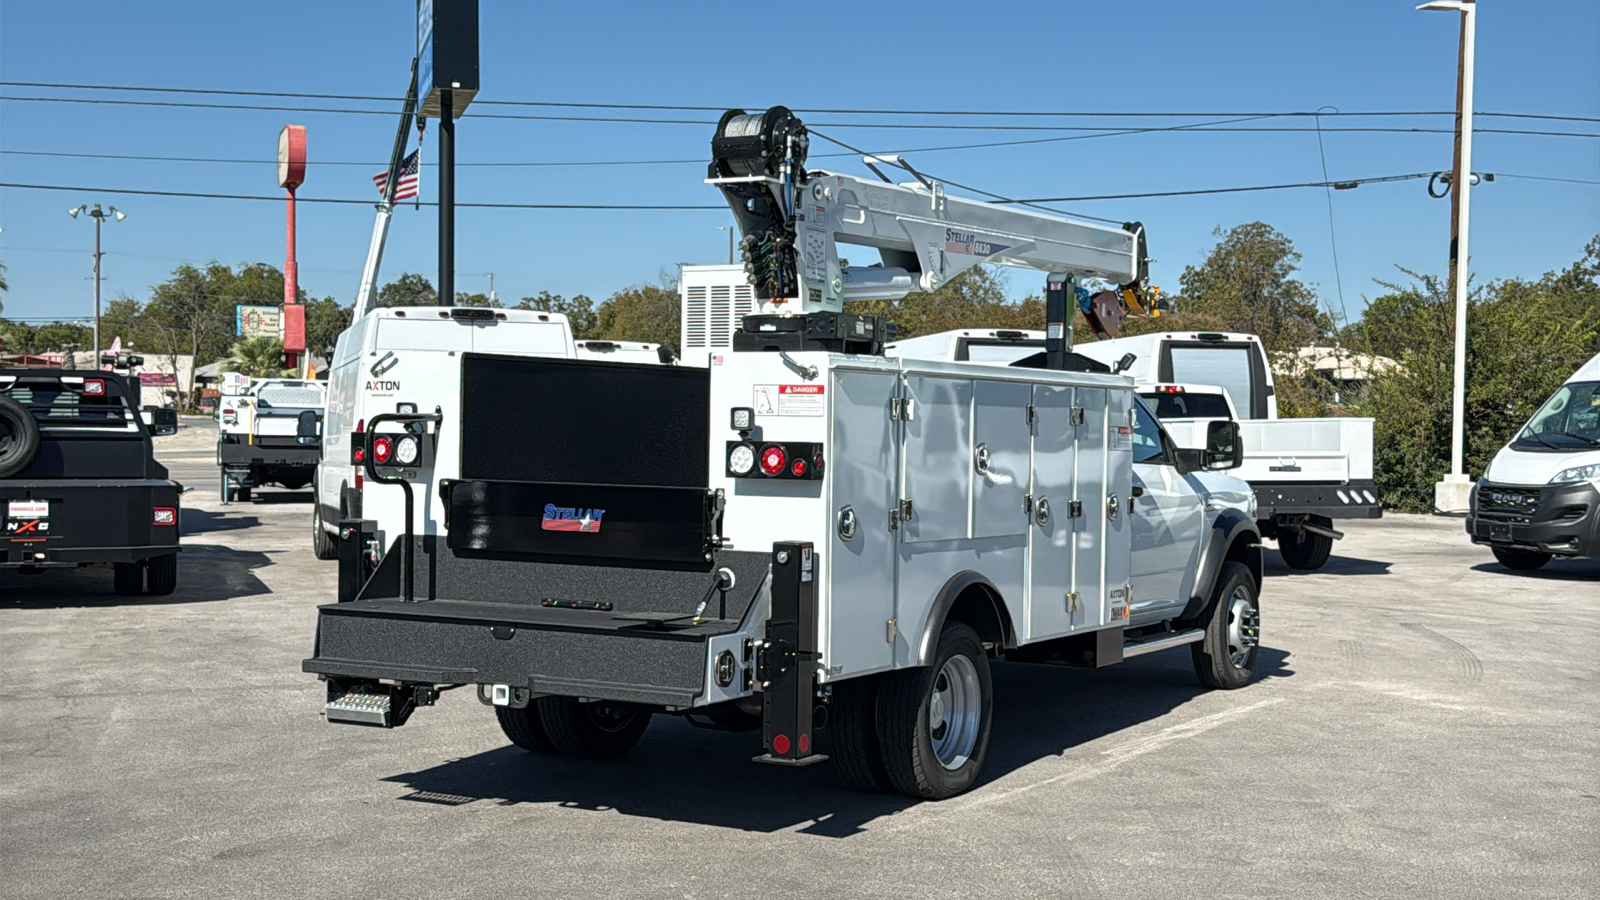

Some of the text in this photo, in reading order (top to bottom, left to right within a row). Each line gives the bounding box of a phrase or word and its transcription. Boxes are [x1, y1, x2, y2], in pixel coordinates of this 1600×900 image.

[946, 228, 975, 244] STELLAR
[366, 380, 400, 390] AXTON
[543, 503, 603, 521] STELLAR
